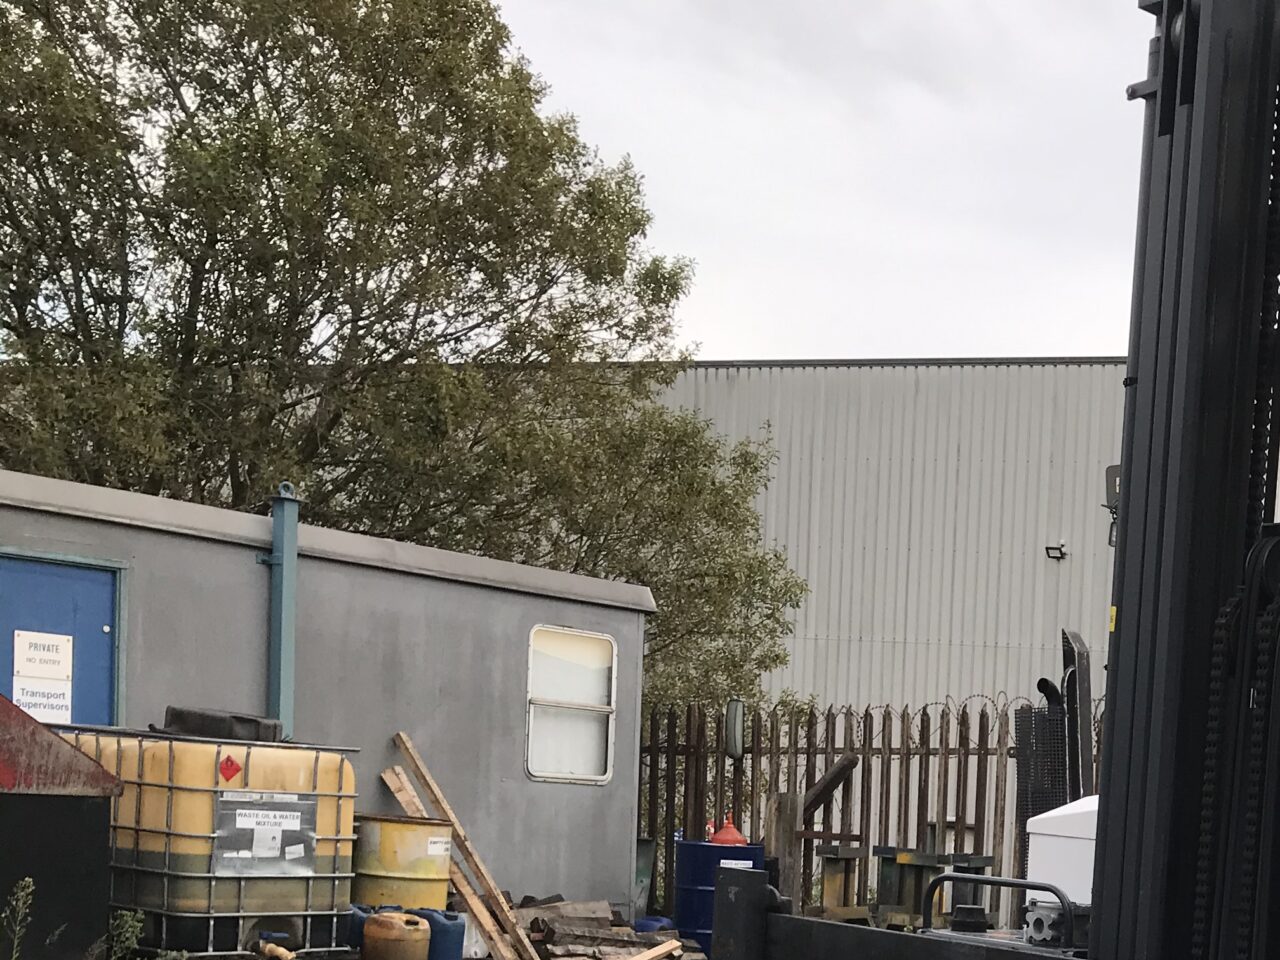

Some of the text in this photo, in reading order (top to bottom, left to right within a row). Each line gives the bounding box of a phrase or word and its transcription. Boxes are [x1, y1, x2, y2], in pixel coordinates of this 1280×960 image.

[28, 641, 60, 654] PRIVATE
[39, 658, 61, 666] ENTRY
[20, 687, 66, 701] Transport
[15, 698, 70, 712] Supervisors
[237, 812, 260, 820] WASTE
[255, 820, 283, 828] MIXTURE
